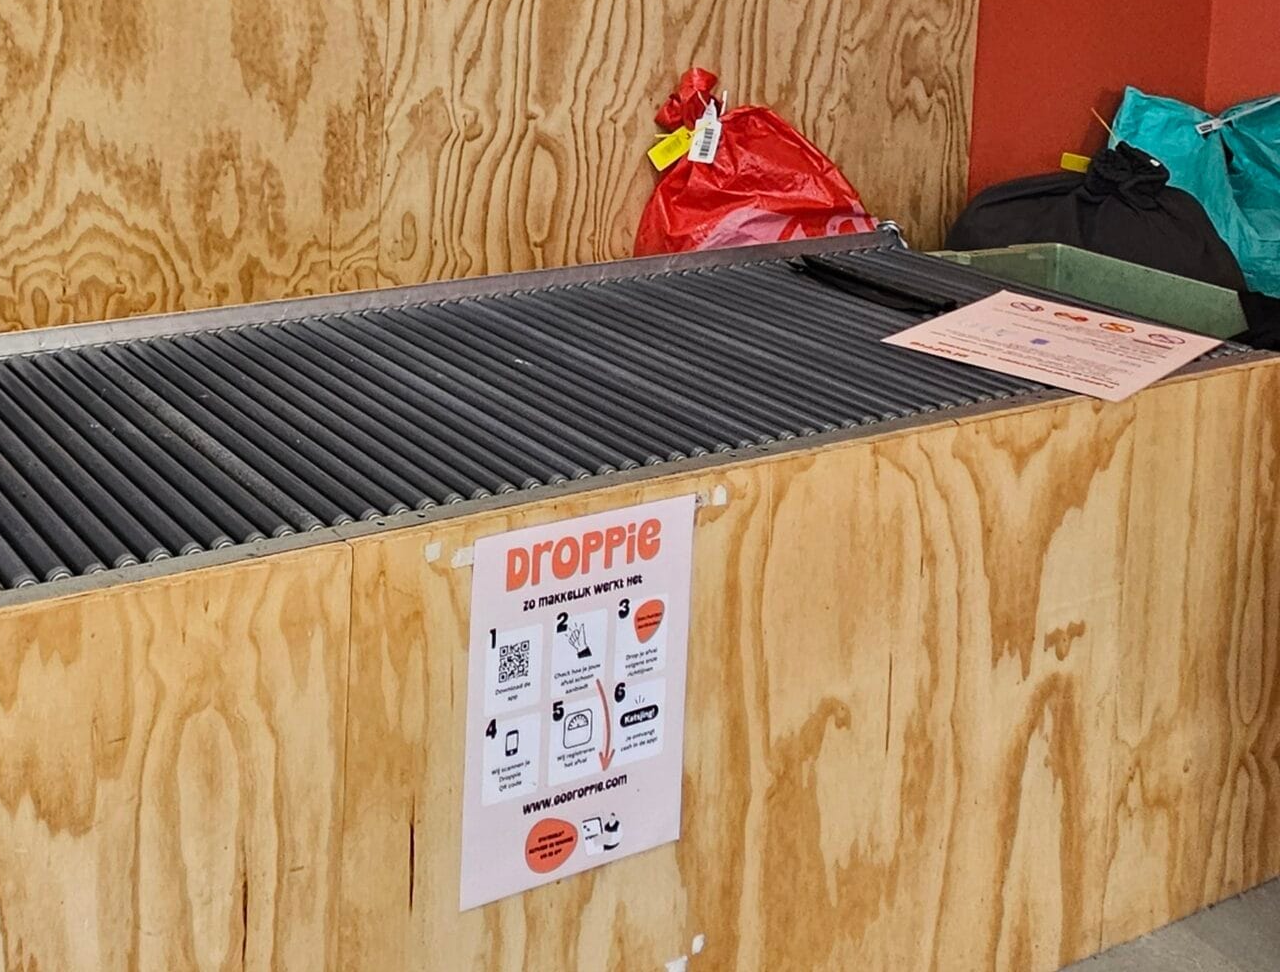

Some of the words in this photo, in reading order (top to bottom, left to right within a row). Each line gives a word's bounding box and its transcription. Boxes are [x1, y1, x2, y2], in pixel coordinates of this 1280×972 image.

[506, 518, 662, 592] Droppie
[618, 598, 630, 619] 3
[557, 612, 568, 633] 2
[489, 628, 496, 649] 1
[614, 682, 626, 703] 6
[552, 700, 564, 722] 5
[485, 718, 497, 739] 4
